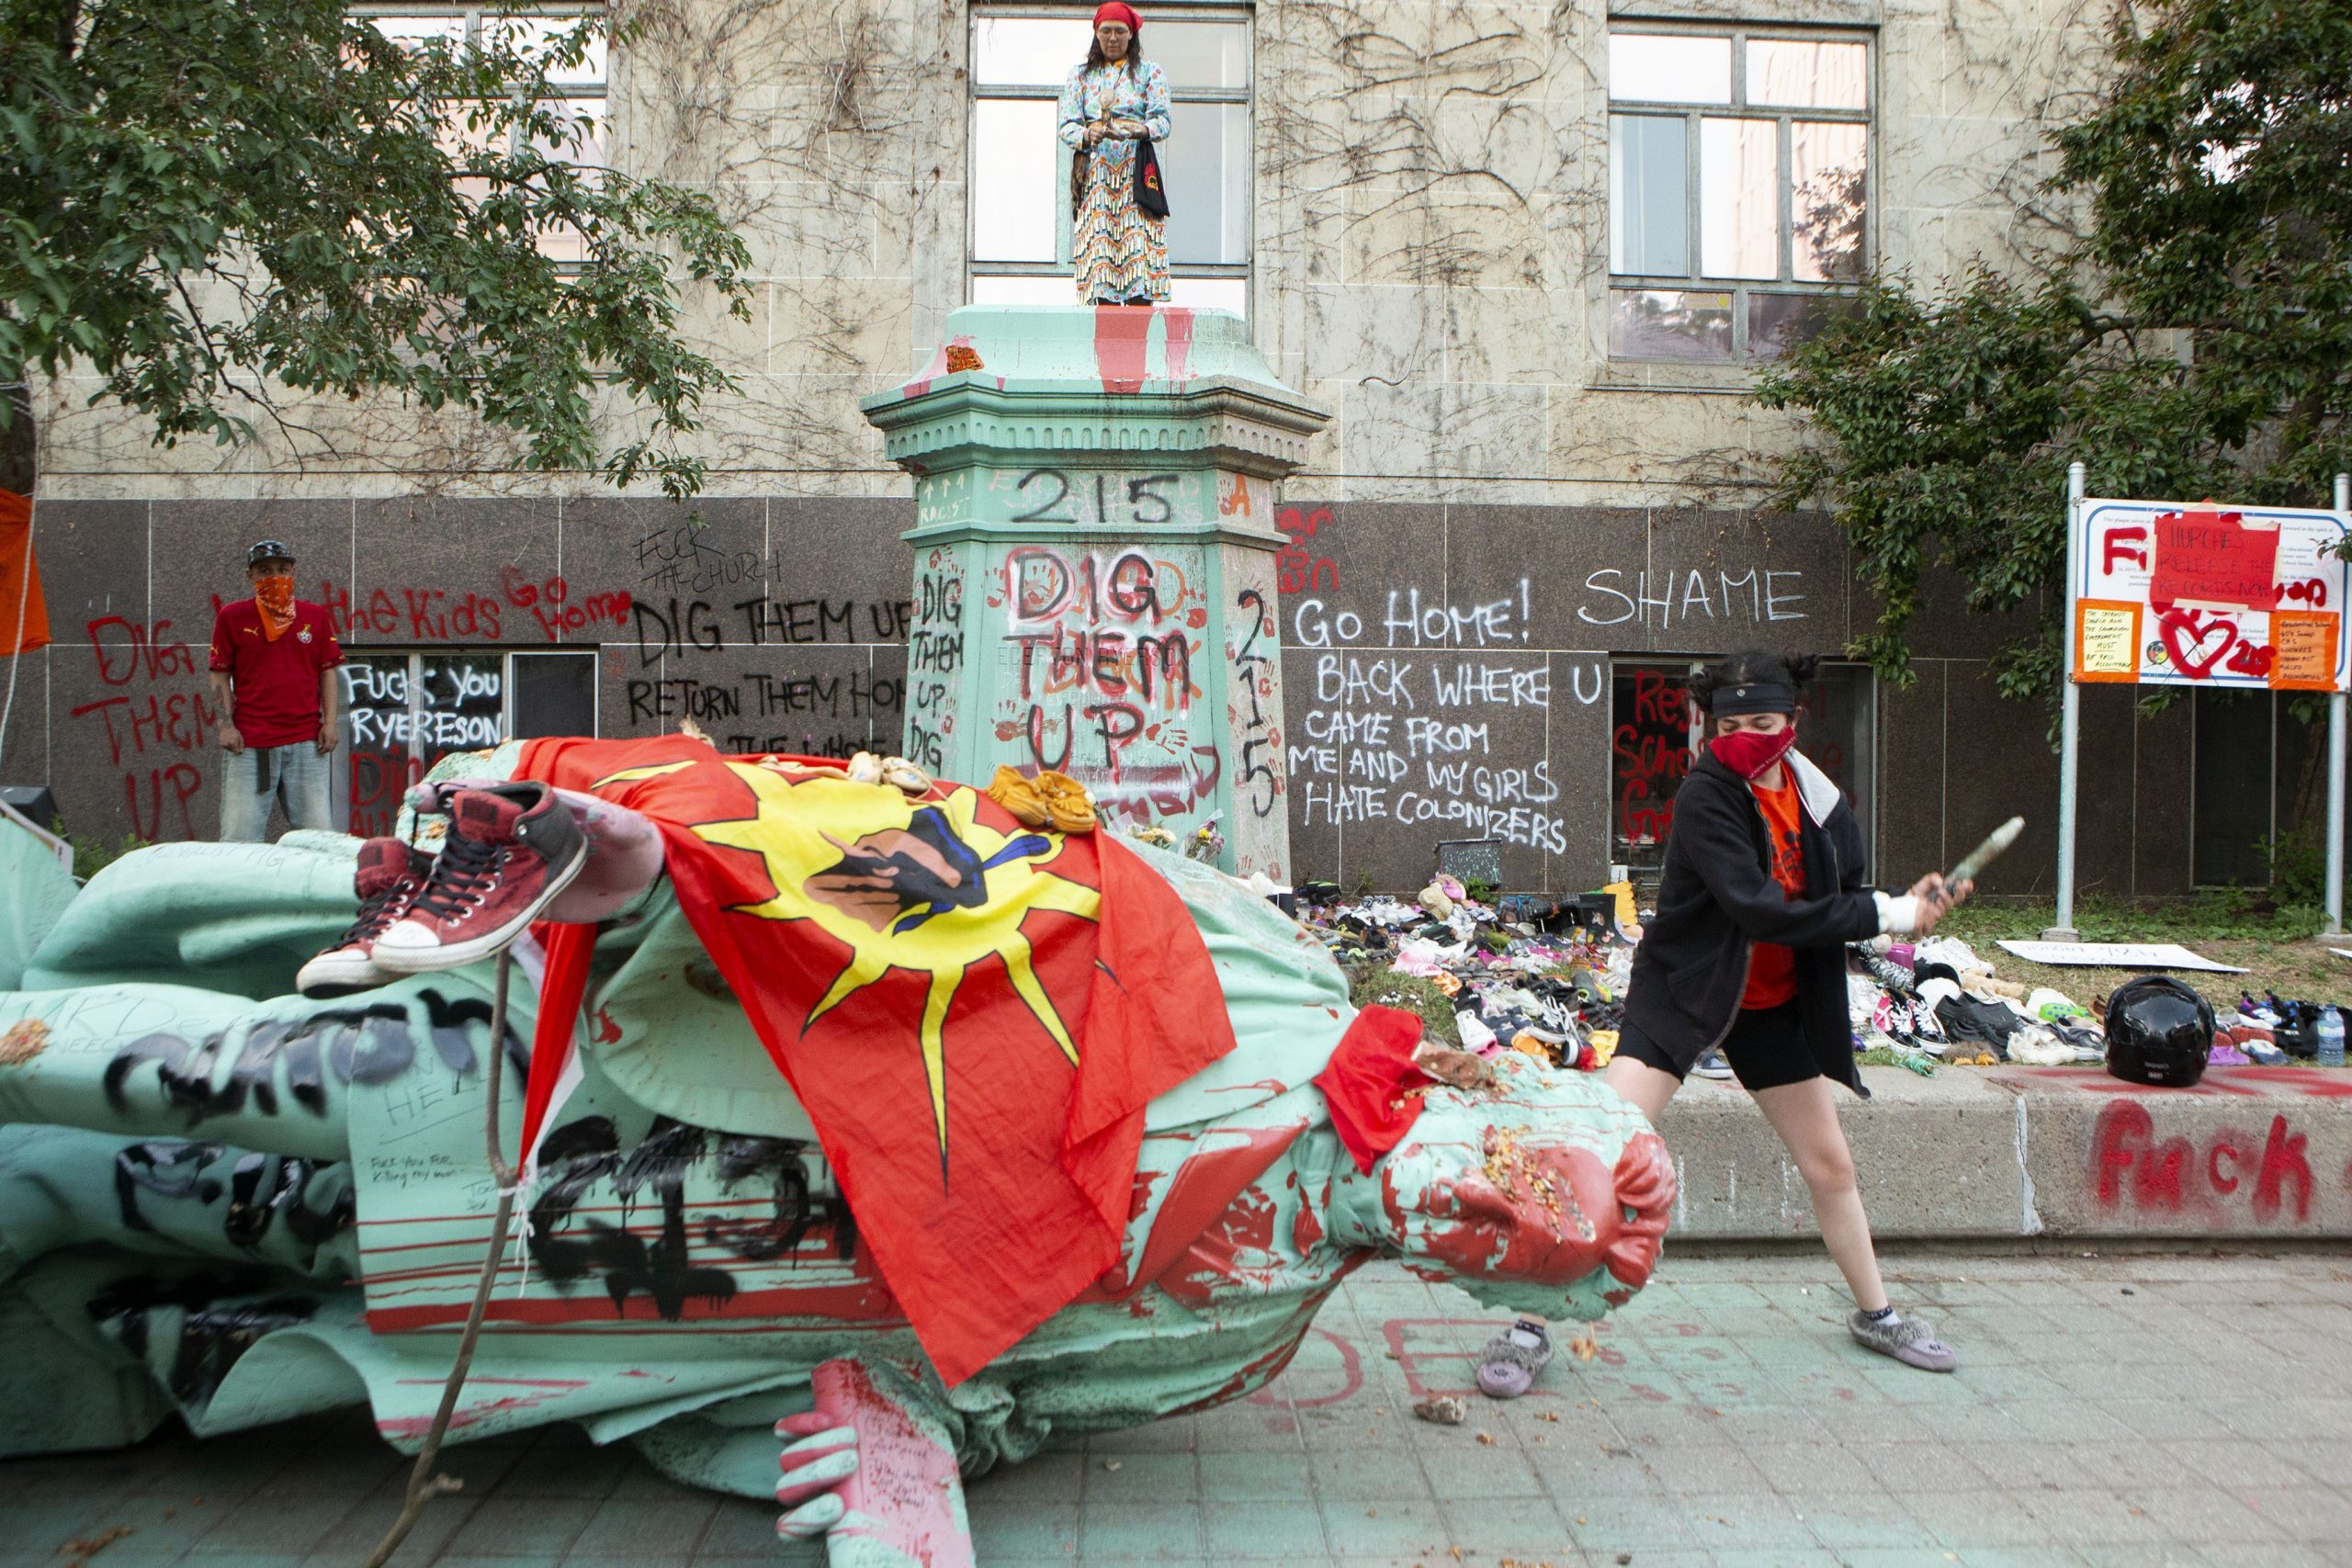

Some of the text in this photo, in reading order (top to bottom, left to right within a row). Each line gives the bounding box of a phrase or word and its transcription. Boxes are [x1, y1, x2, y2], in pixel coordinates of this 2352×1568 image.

[1012, 468, 1179, 524] 215
[922, 573, 962, 628] DIG
[1007, 547, 1160, 628] DIG
[1384, 578, 1529, 647] HOME!
[1577, 569, 1809, 629] SHAME
[87, 616, 195, 686] DIG
[632, 599, 724, 669] DIG
[735, 597, 854, 644] THEM
[912, 631, 965, 673] THEM
[1002, 621, 1190, 711] THEM
[1317, 654, 1602, 709] BACK WHERE U
[350, 707, 503, 749] RYERESON
[628, 679, 740, 725] RETURN
[744, 672, 839, 718] THEM
[918, 681, 945, 718] UP
[908, 716, 942, 778] DIG
[1026, 701, 1145, 781] UP
[1306, 710, 1489, 754] CAME FROM
[126, 762, 201, 841] UP
[1289, 745, 1559, 804] ME AND MY GIRLS
[1304, 782, 1567, 855] HATE COLONIZERS
